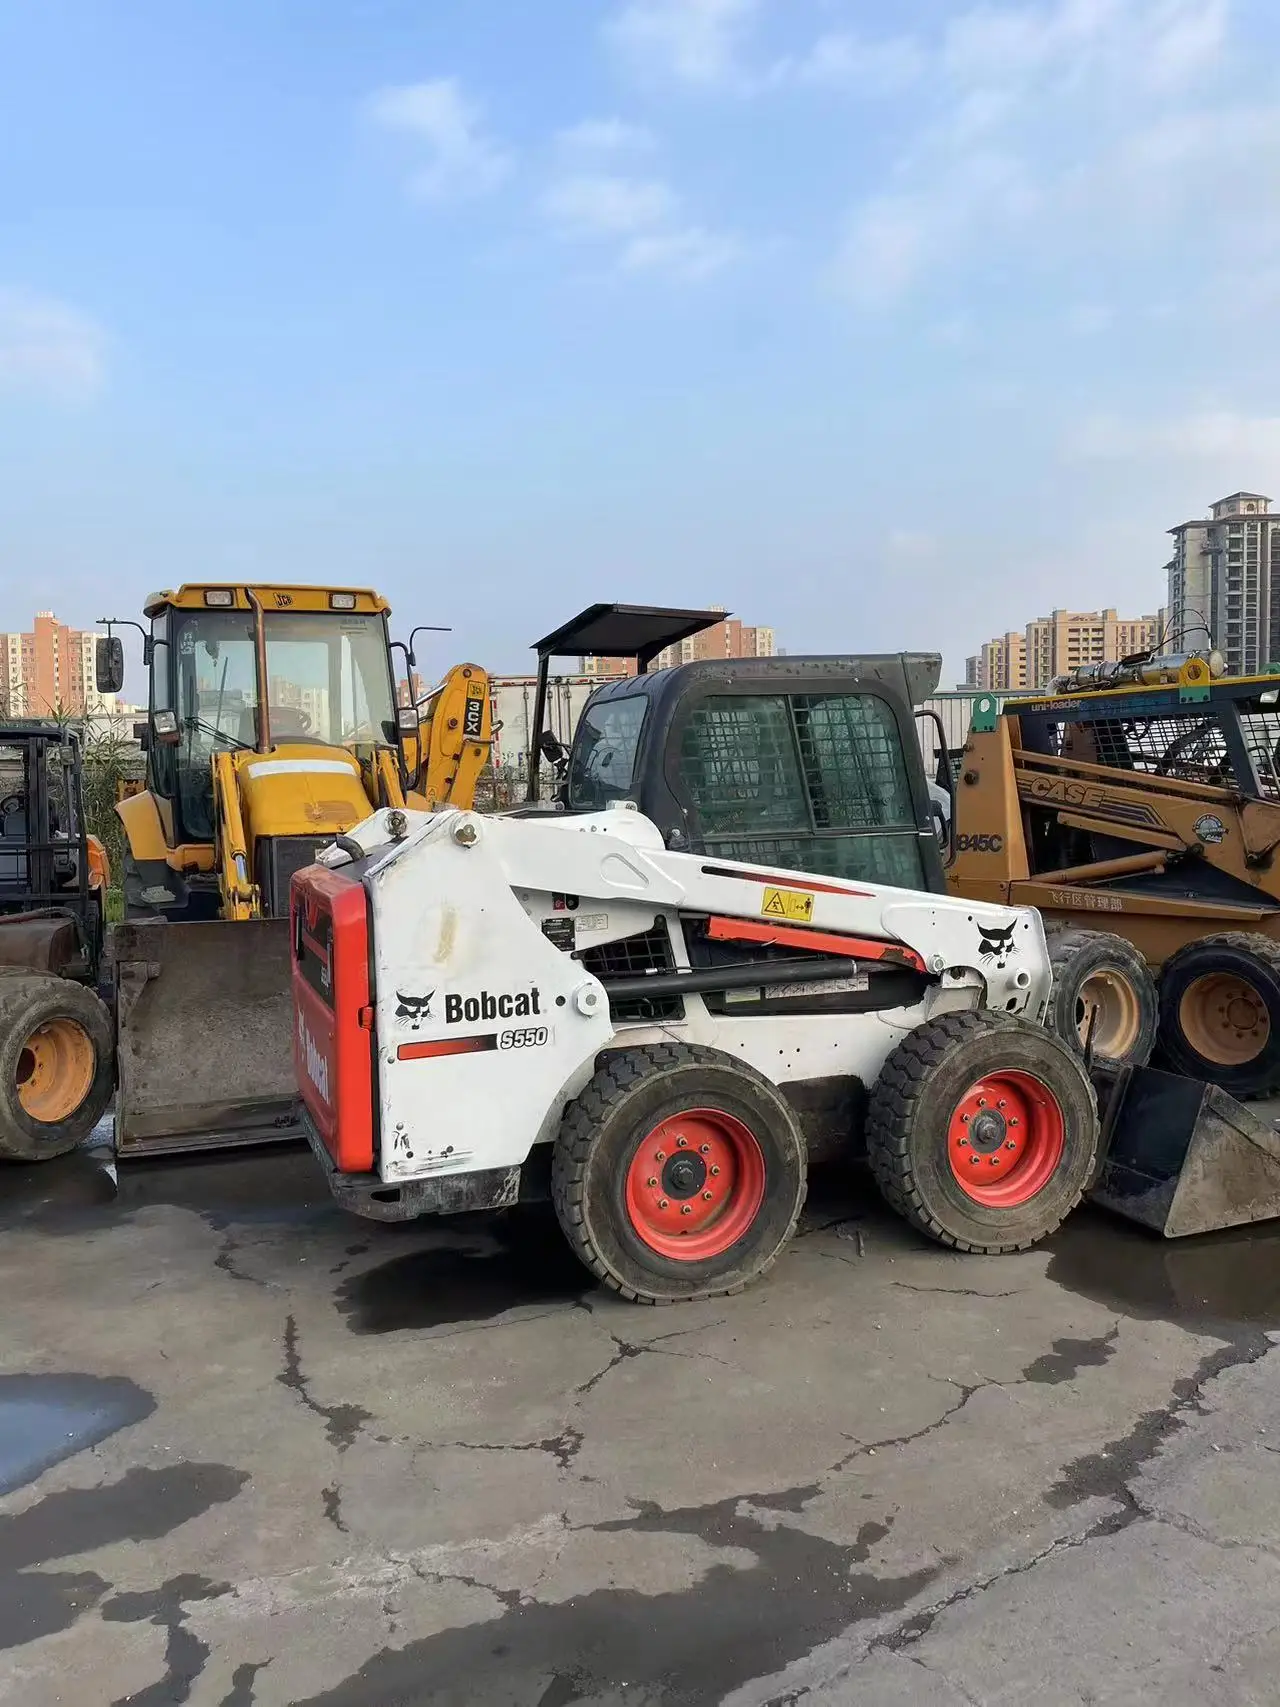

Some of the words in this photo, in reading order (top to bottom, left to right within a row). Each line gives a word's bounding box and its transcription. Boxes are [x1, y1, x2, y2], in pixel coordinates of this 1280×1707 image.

[466, 701, 480, 733] 3CX
[1031, 777, 1105, 807] CASE
[445, 987, 541, 1024] Bobcat
[500, 1027, 548, 1050] S550
